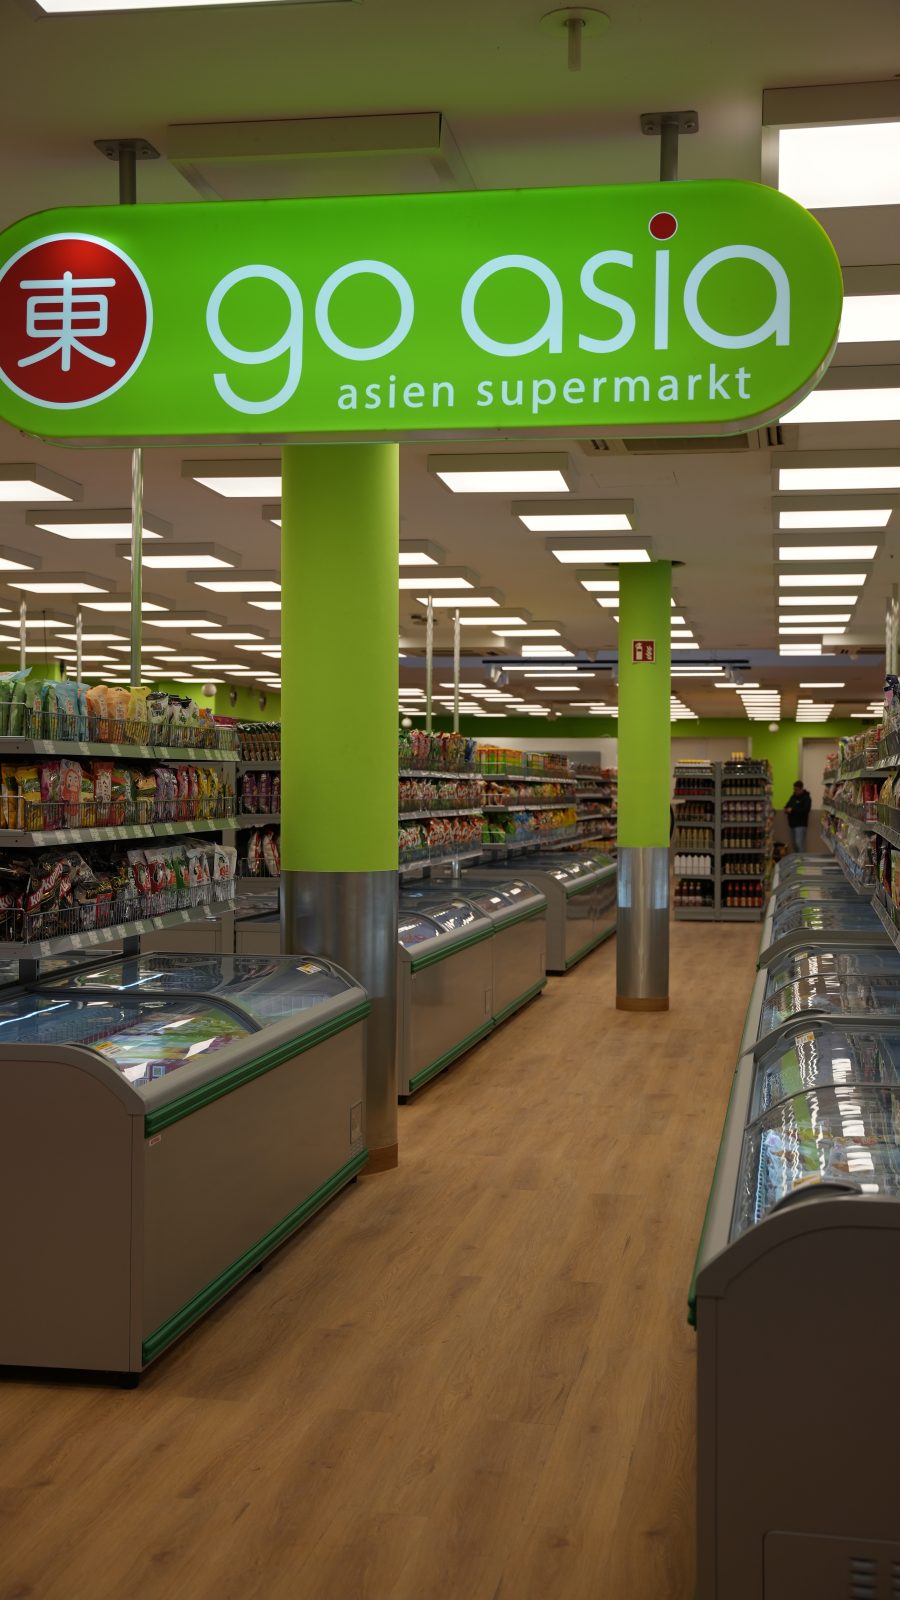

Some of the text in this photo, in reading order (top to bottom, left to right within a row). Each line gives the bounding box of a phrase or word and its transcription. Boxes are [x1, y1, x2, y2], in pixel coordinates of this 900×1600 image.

[17, 269, 117, 372] 東
[205, 211, 791, 416] go asia
[337, 363, 753, 414] asien supermarkt
